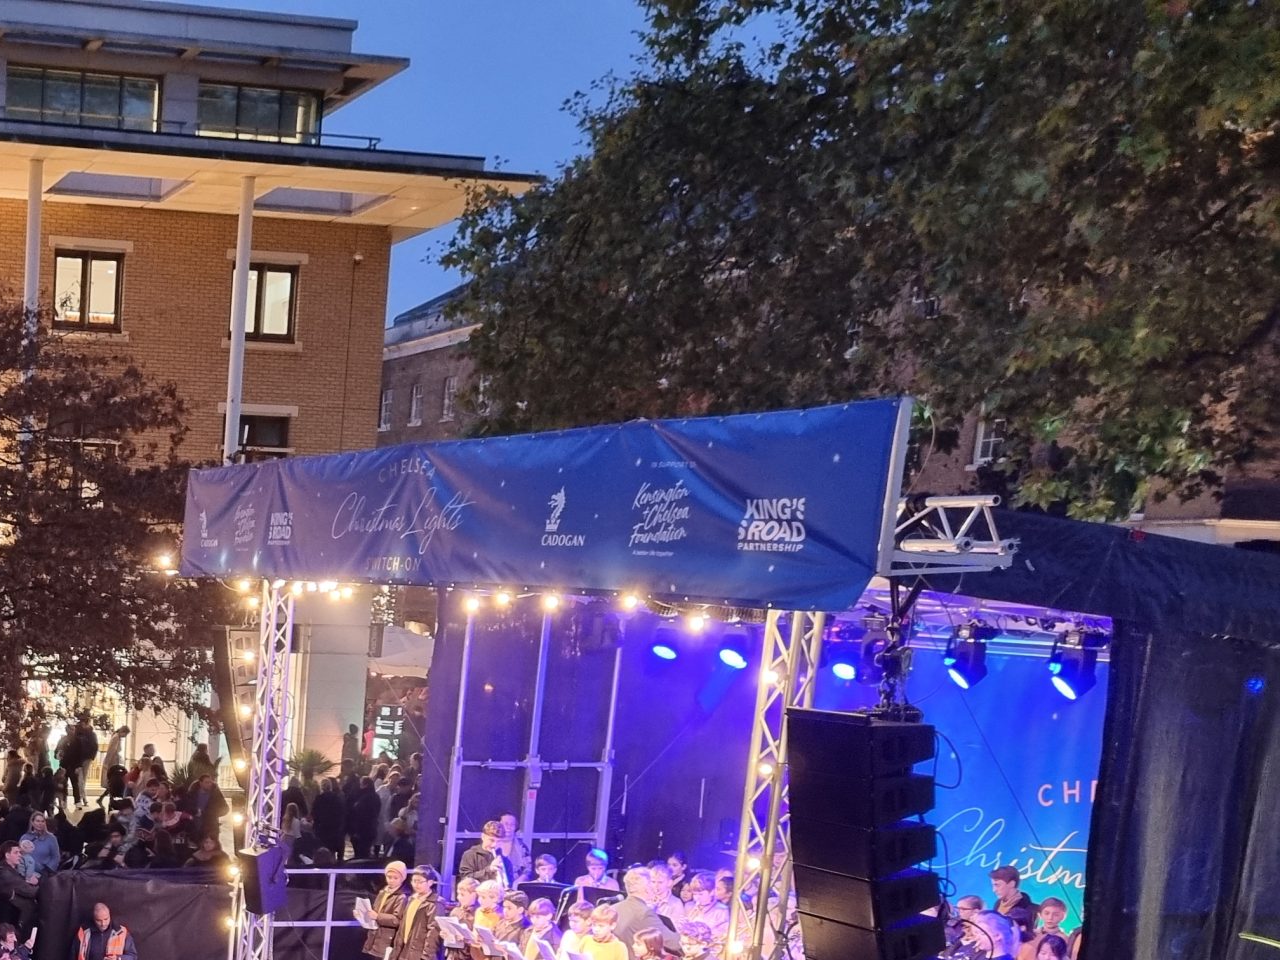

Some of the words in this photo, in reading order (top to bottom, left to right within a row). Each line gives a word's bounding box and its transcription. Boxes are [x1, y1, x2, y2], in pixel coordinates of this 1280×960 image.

[378, 458, 436, 483] CHELSEA
[632, 479, 690, 512] Kensington
[331, 491, 405, 539] Christmas
[400, 487, 478, 555] Lights
[644, 502, 690, 531] Chelsea
[744, 497, 806, 520] KING'S
[541, 534, 586, 547] CADOGAN
[628, 522, 687, 547] Foundation
[737, 542, 804, 552] PARTNERSHIP
[365, 557, 420, 572] SWITCH-ON
